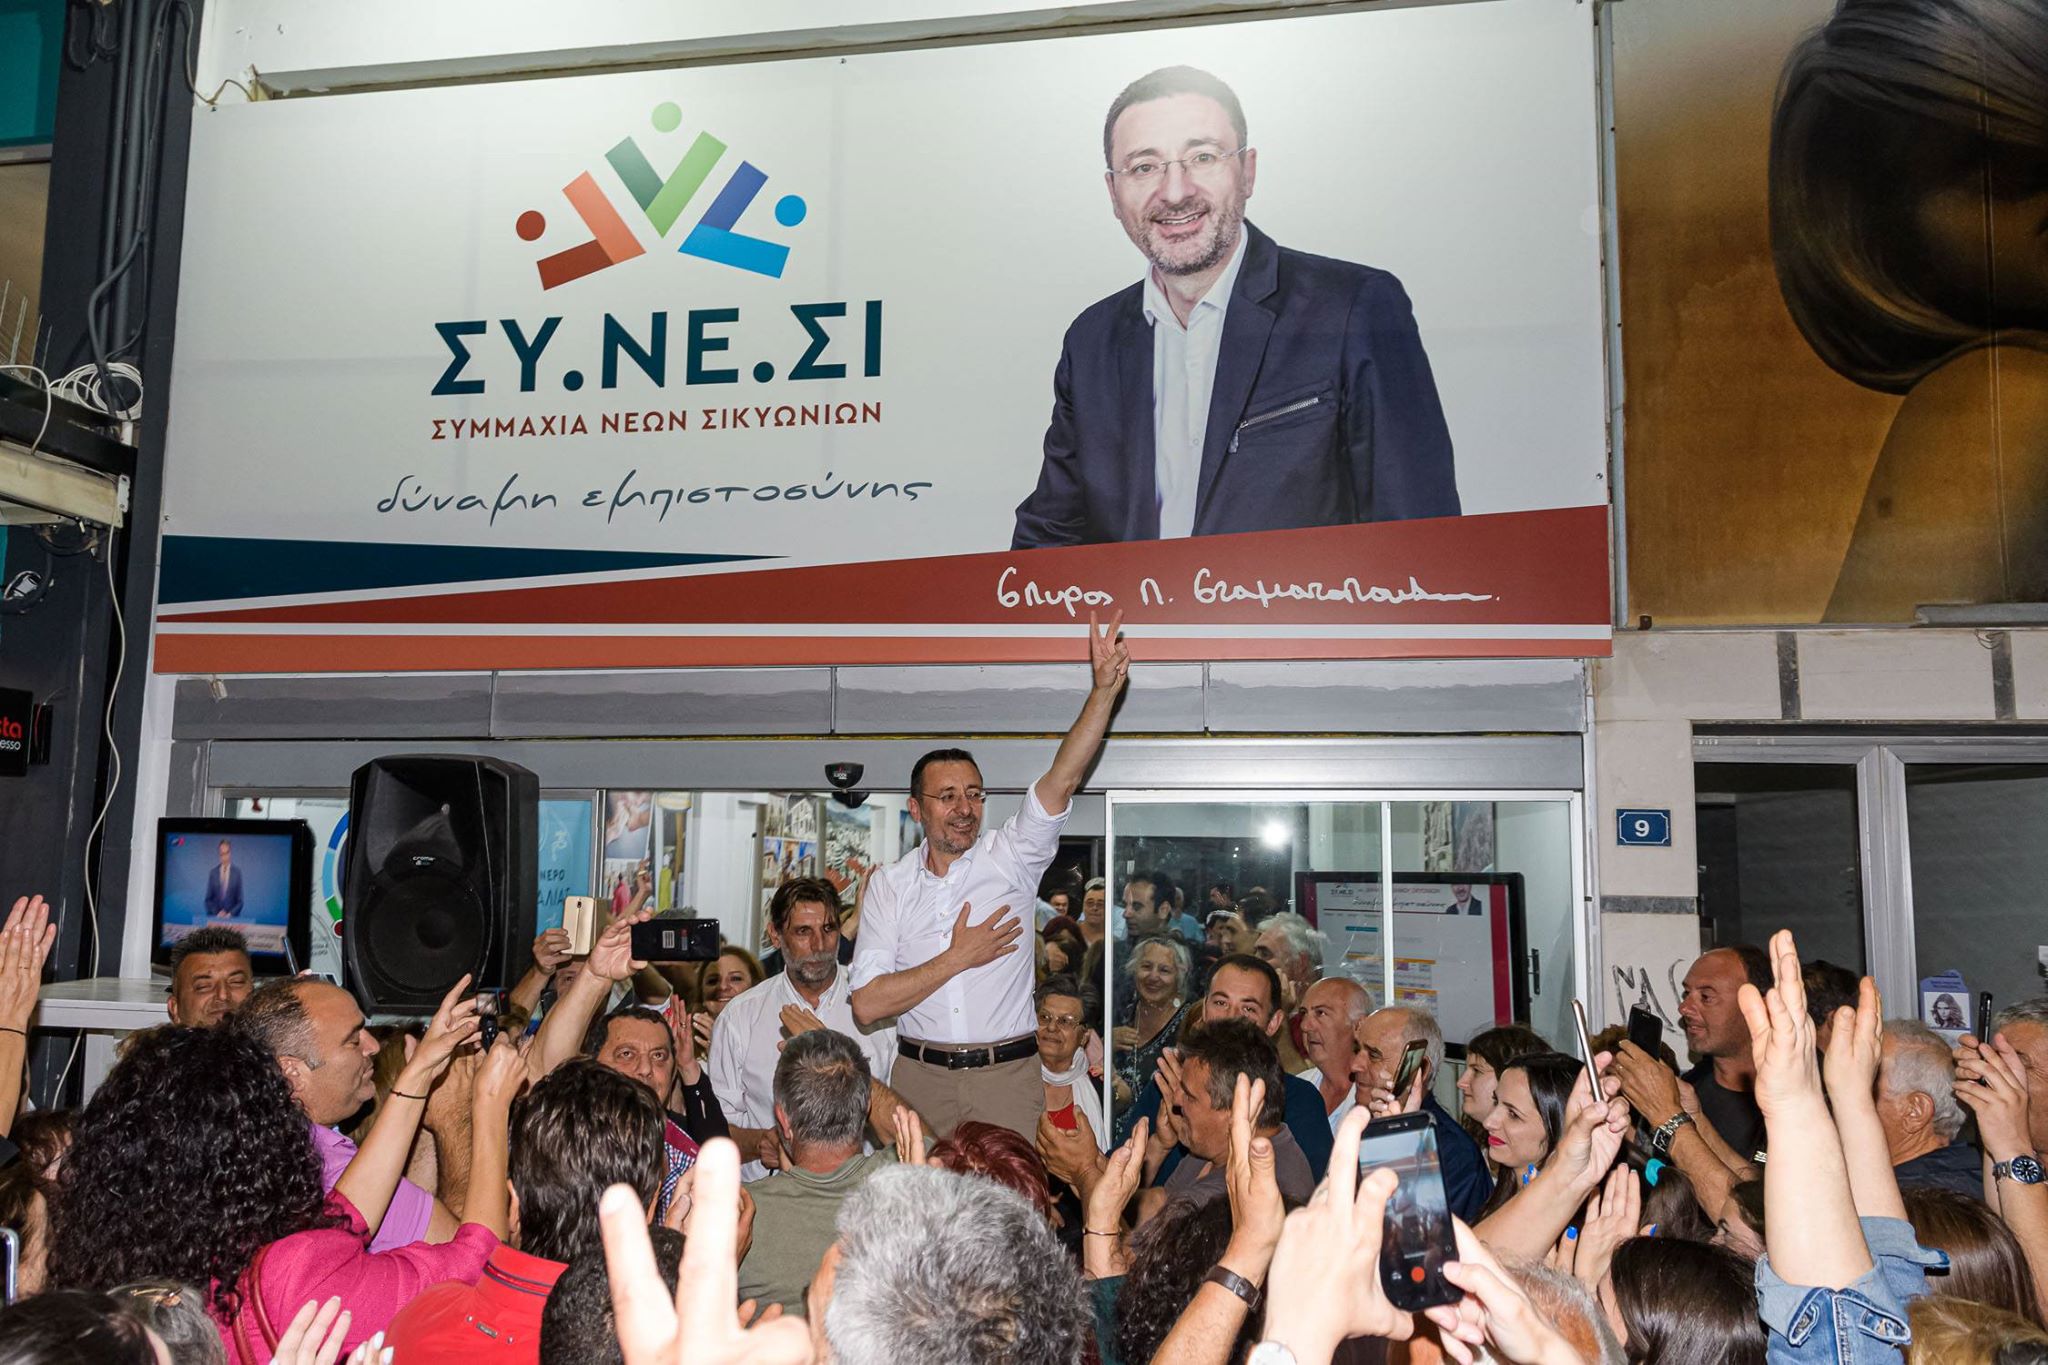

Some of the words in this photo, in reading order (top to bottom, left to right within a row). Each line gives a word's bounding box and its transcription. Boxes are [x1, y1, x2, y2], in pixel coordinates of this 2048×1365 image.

[430, 299, 883, 396] ΣΥ.ΝΕ.ΣΙ
[431, 414, 588, 440] ΣΥΜΜΑΧΙΑ
[602, 410, 688, 434] ΝΕΩΝ
[702, 402, 882, 431] ΣΙΚΥΩΝΙΩΝ
[377, 472, 557, 527] δύναμη
[582, 469, 933, 525] εμπιστοσύνης
[0, 716, 22, 737] ta
[1634, 819, 1650, 837] 9
